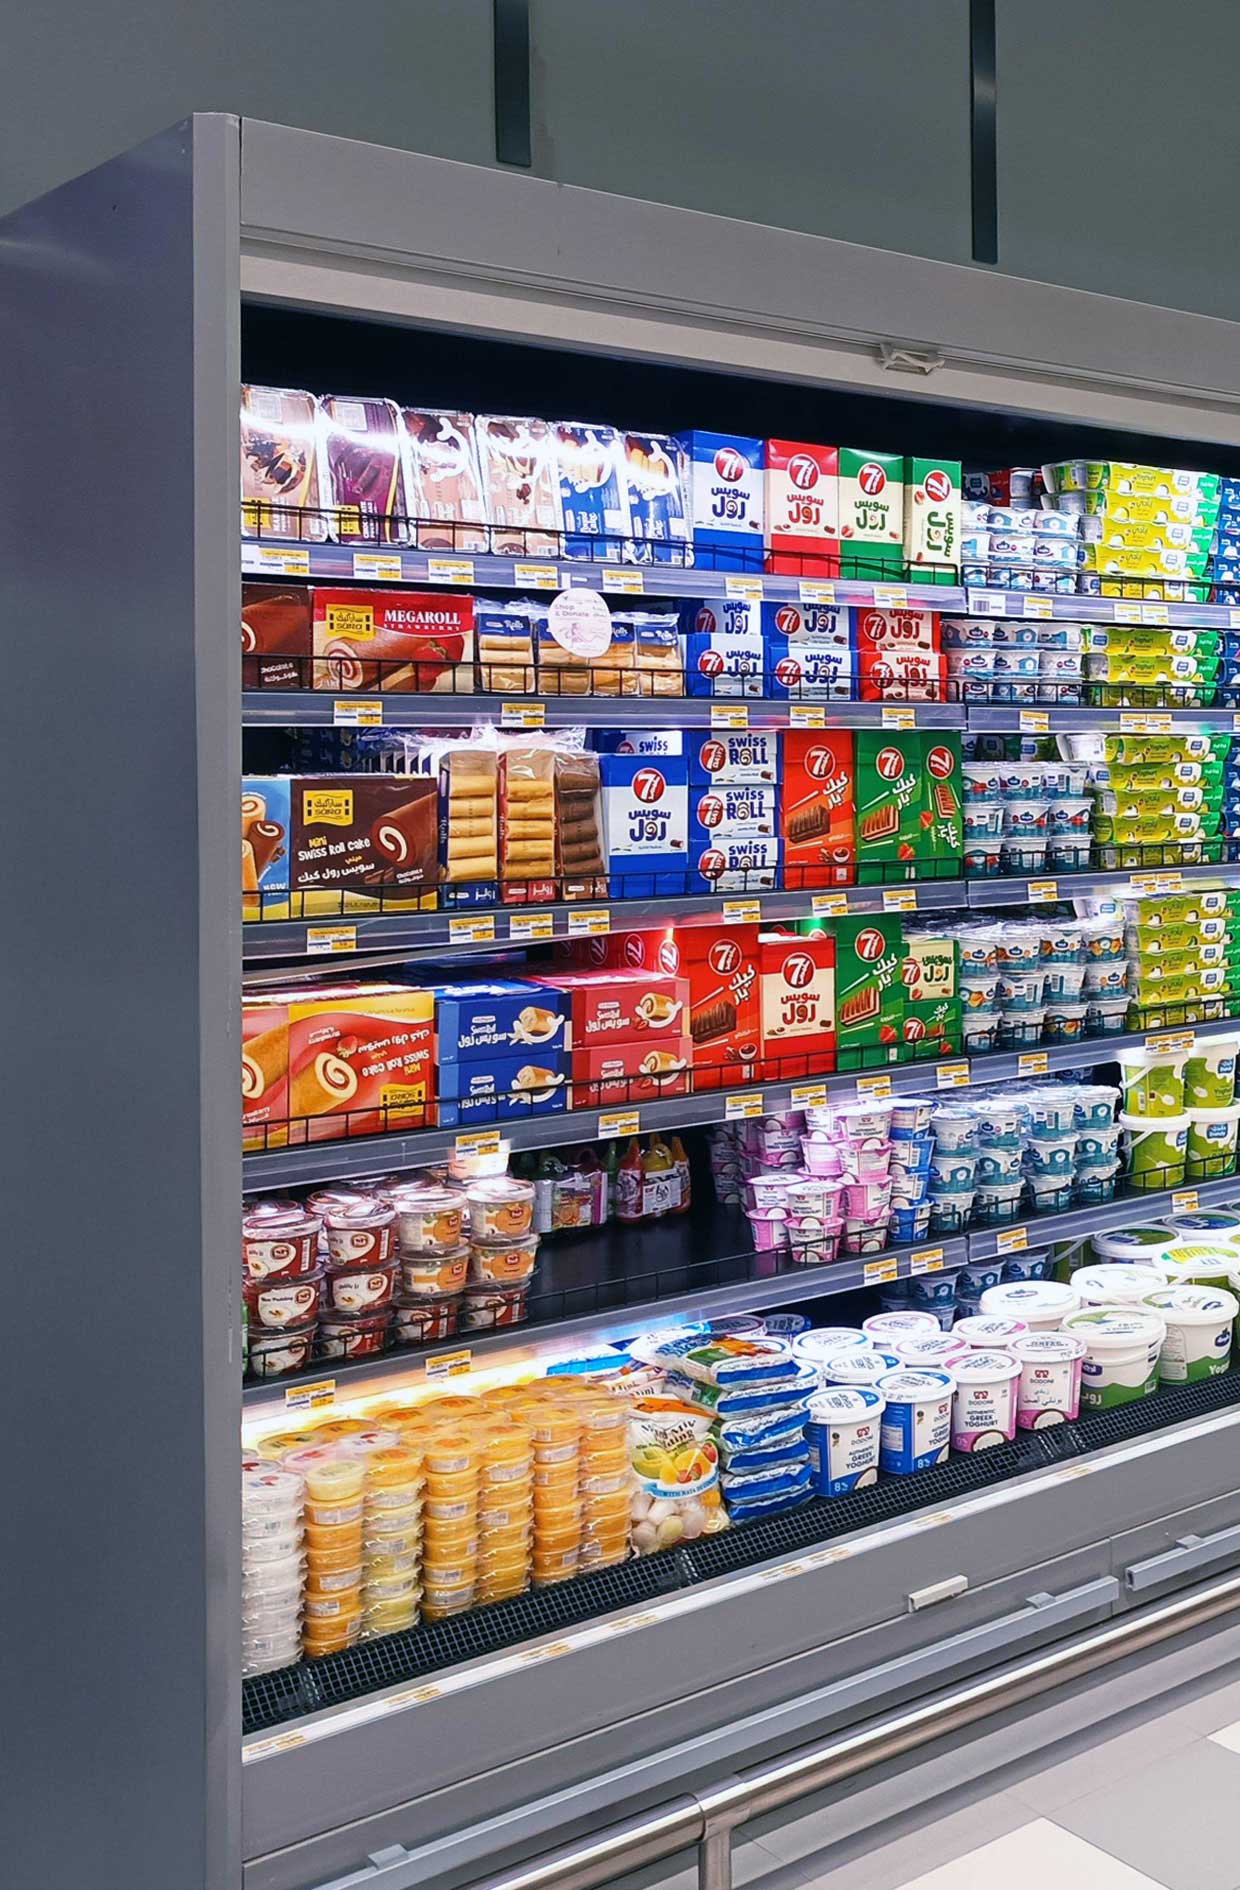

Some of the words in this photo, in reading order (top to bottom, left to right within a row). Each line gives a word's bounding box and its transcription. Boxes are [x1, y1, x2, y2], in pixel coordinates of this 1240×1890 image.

[383, 609, 462, 625] MEGAROLL
[383, 623, 462, 632] STRAWBERRY
[729, 747, 769, 767] ROLL
[628, 808, 672, 822] سويس
[726, 801, 766, 821] ROLL
[629, 818, 668, 842] رول
[780, 992, 821, 1005] سويس
[782, 1001, 818, 1026] رول
[964, 1419, 999, 1428] YOGHURT
[851, 1451, 873, 1462] GREEK
